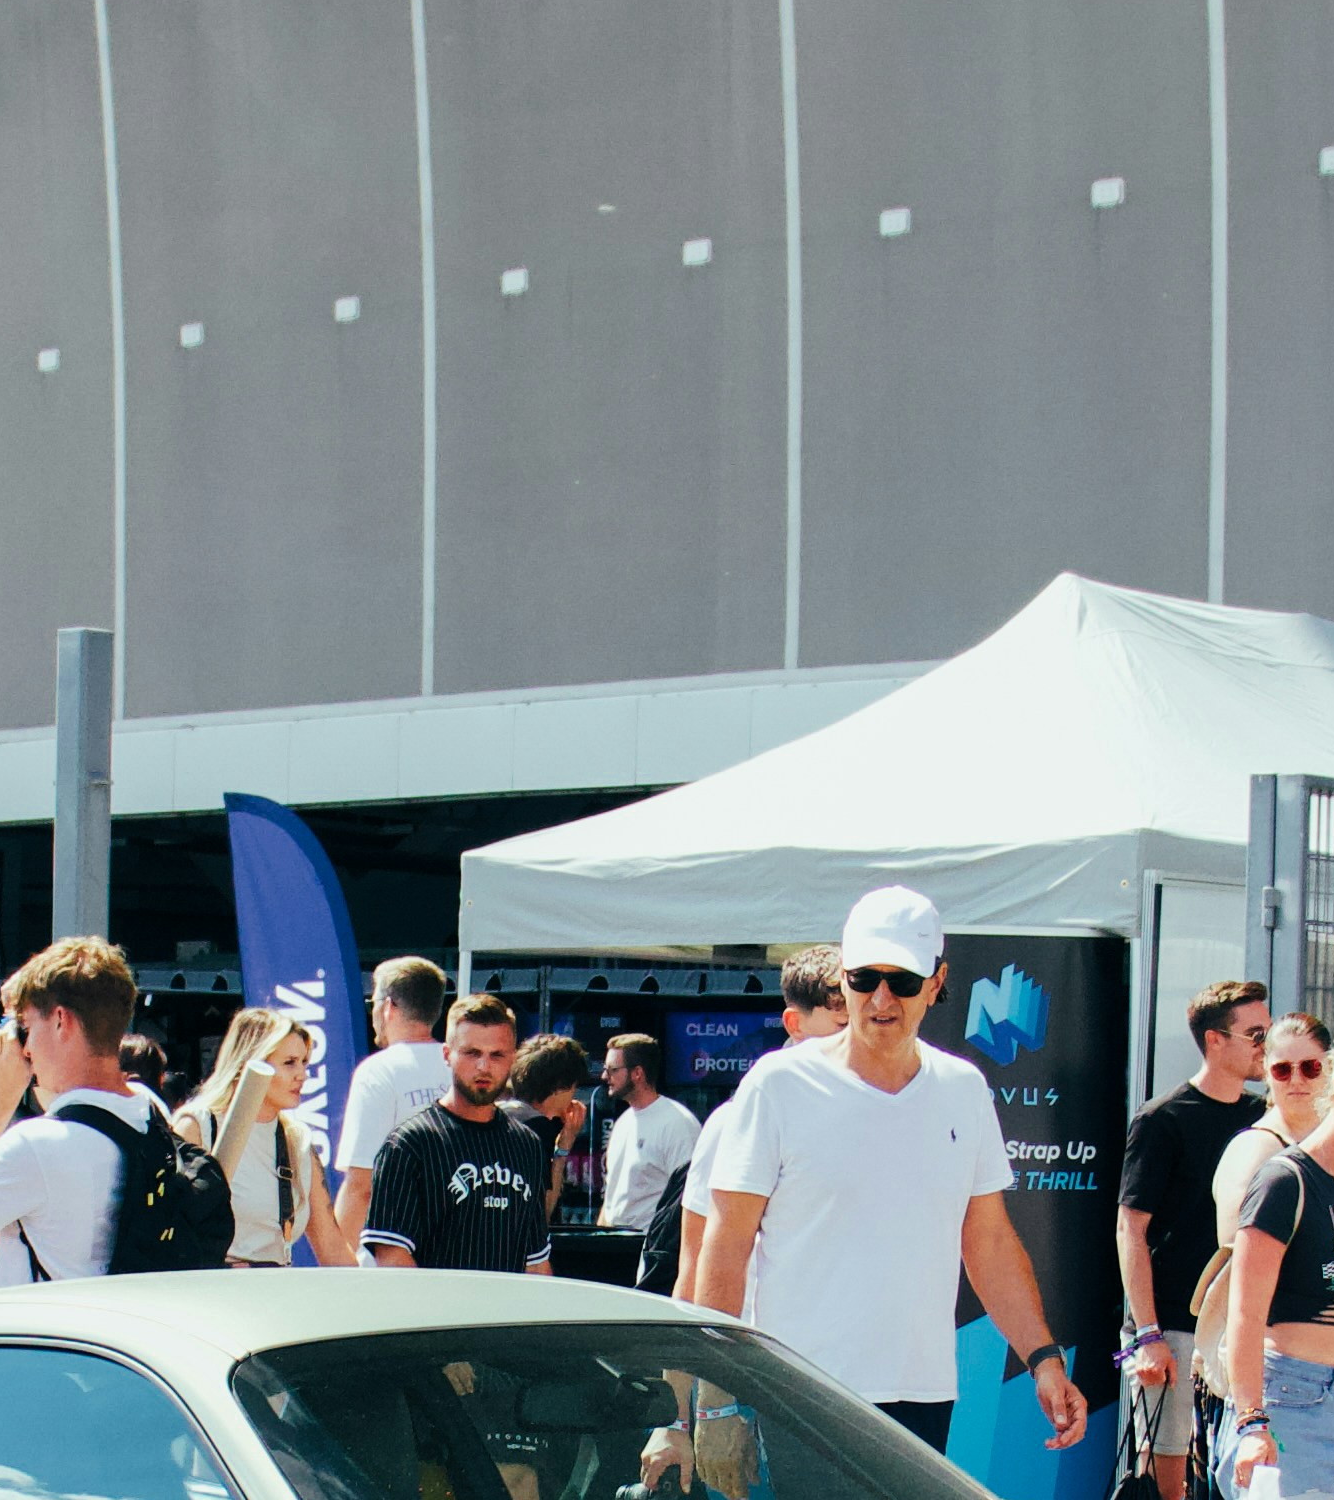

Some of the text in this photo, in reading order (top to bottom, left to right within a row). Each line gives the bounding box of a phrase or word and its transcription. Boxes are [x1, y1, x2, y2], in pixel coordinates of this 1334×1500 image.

[685, 1023, 739, 1037] CLEAN
[1005, 1140, 1097, 1165] Strap Up
[1025, 1171, 1098, 1191] THRILL
[483, 1195, 509, 1210] stop
